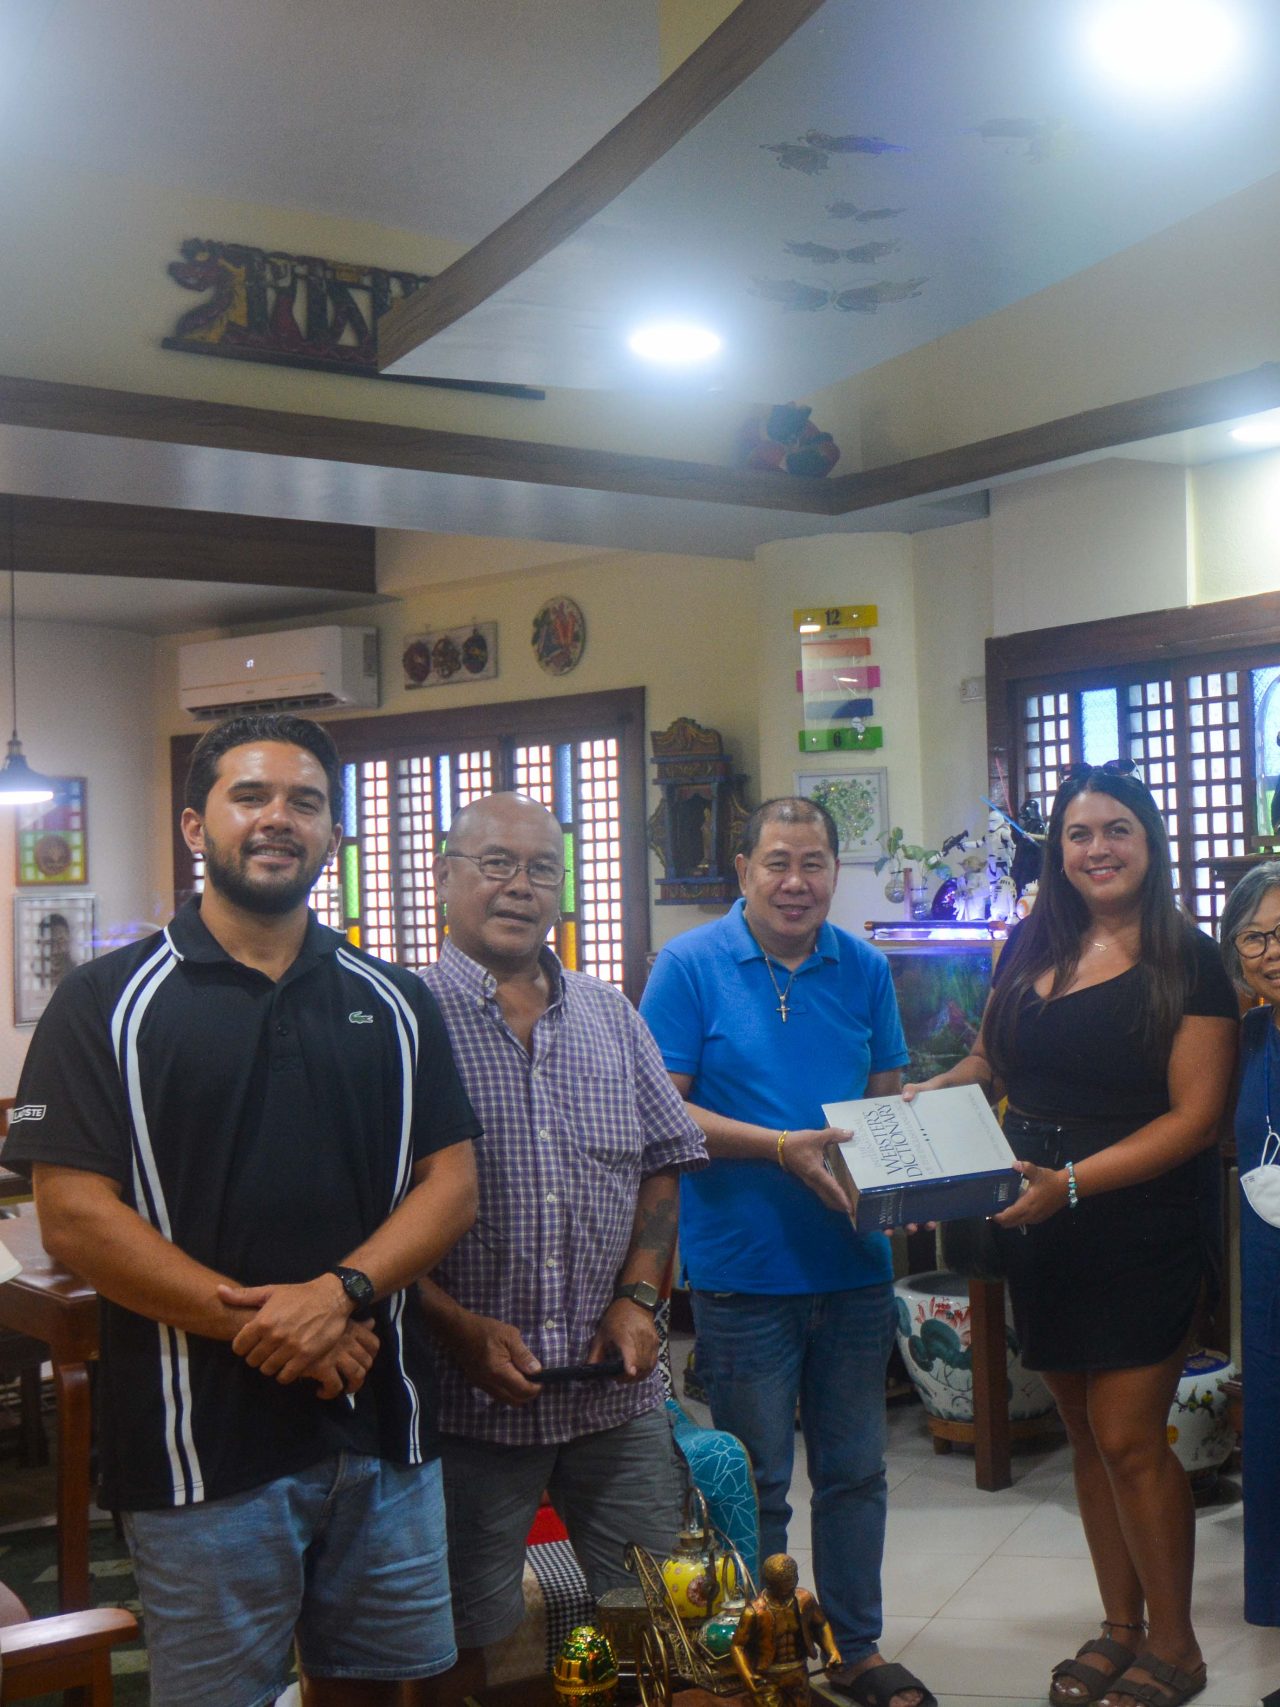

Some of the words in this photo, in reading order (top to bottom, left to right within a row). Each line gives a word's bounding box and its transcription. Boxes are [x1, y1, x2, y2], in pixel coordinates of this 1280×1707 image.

[824, 608, 841, 626] 12
[833, 731, 842, 748] 6
[875, 1103, 923, 1178] DICTIONARY
